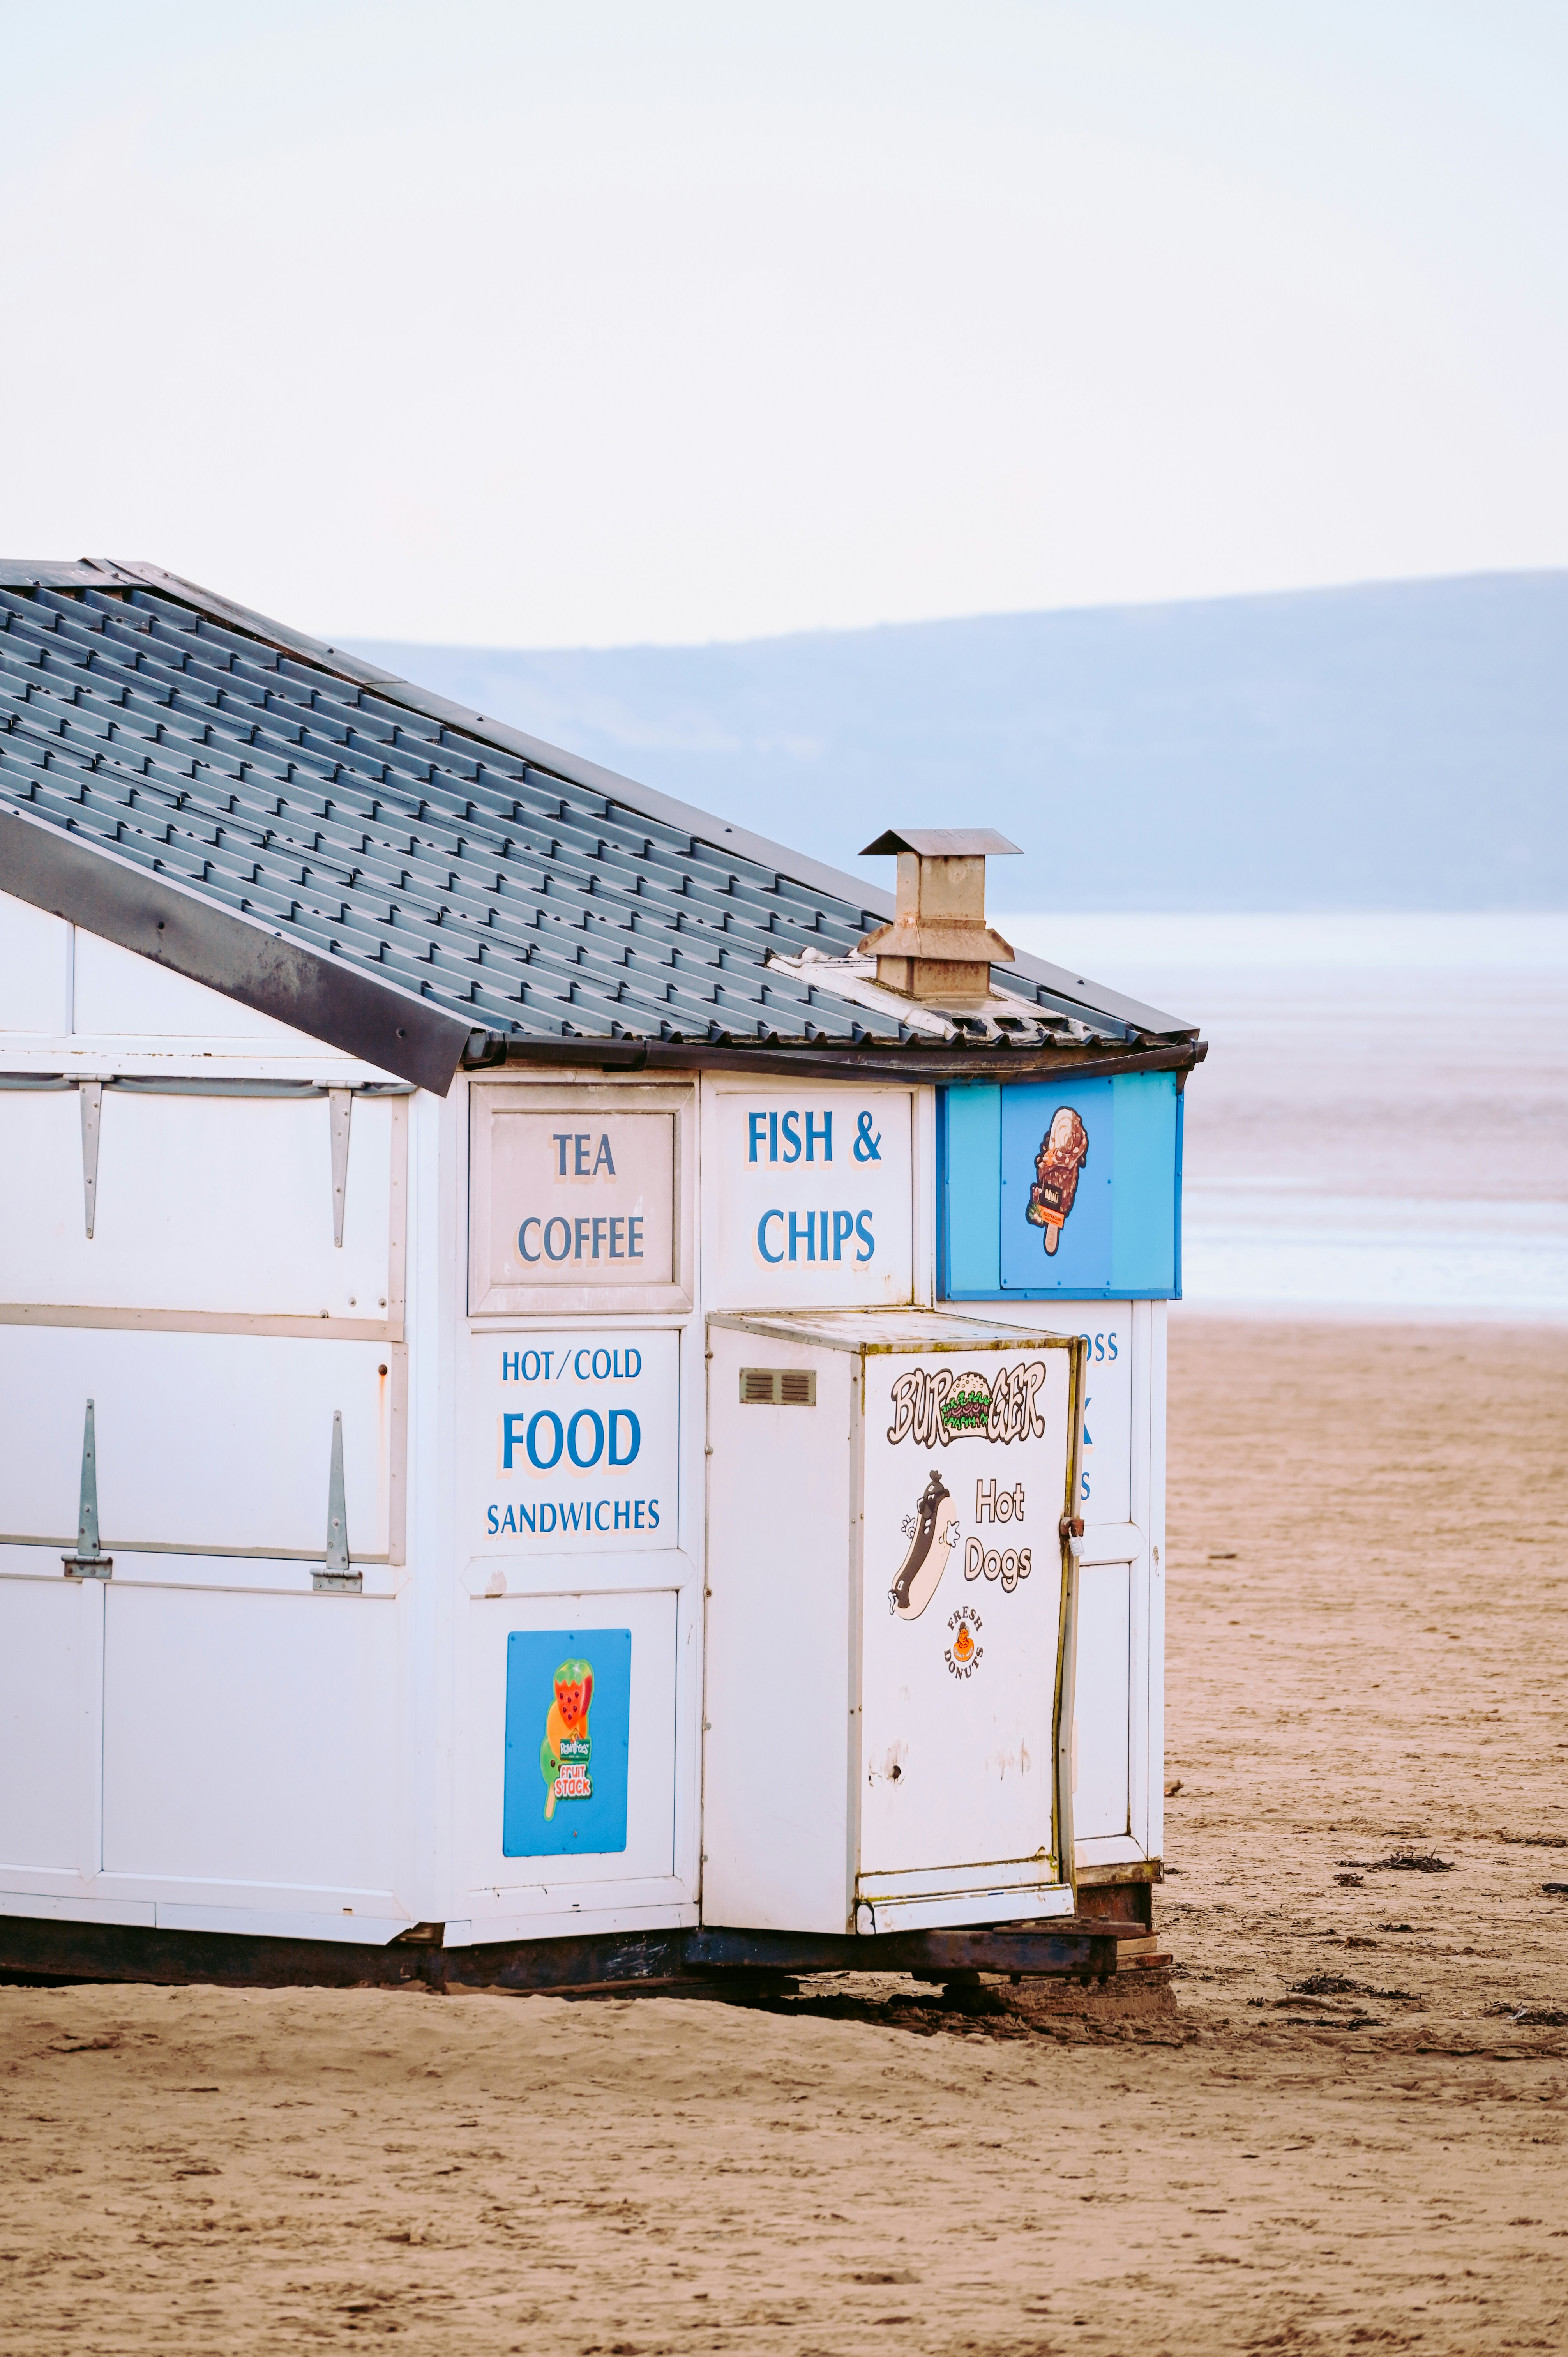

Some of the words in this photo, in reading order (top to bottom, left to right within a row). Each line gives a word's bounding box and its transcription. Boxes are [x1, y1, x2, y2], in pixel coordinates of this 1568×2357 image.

[553, 1133, 616, 1175] TEA
[748, 1110, 833, 1163] FISH
[853, 1111, 882, 1162] &
[518, 1216, 644, 1262] COFFEE
[757, 1209, 875, 1263] CHIPS
[1043, 1211, 1061, 1222] AUSTRALIAN
[502, 1348, 642, 1381] HOT/COLD
[887, 1361, 1046, 1449] BURGER
[503, 1408, 641, 1470] FOOD
[487, 1498, 660, 1535] SANDWICHES
[975, 1478, 1025, 1523] Hot
[964, 1537, 1031, 1593] Dogs
[947, 1606, 983, 1632] FRESH
[944, 1647, 984, 1680] DONUTS
